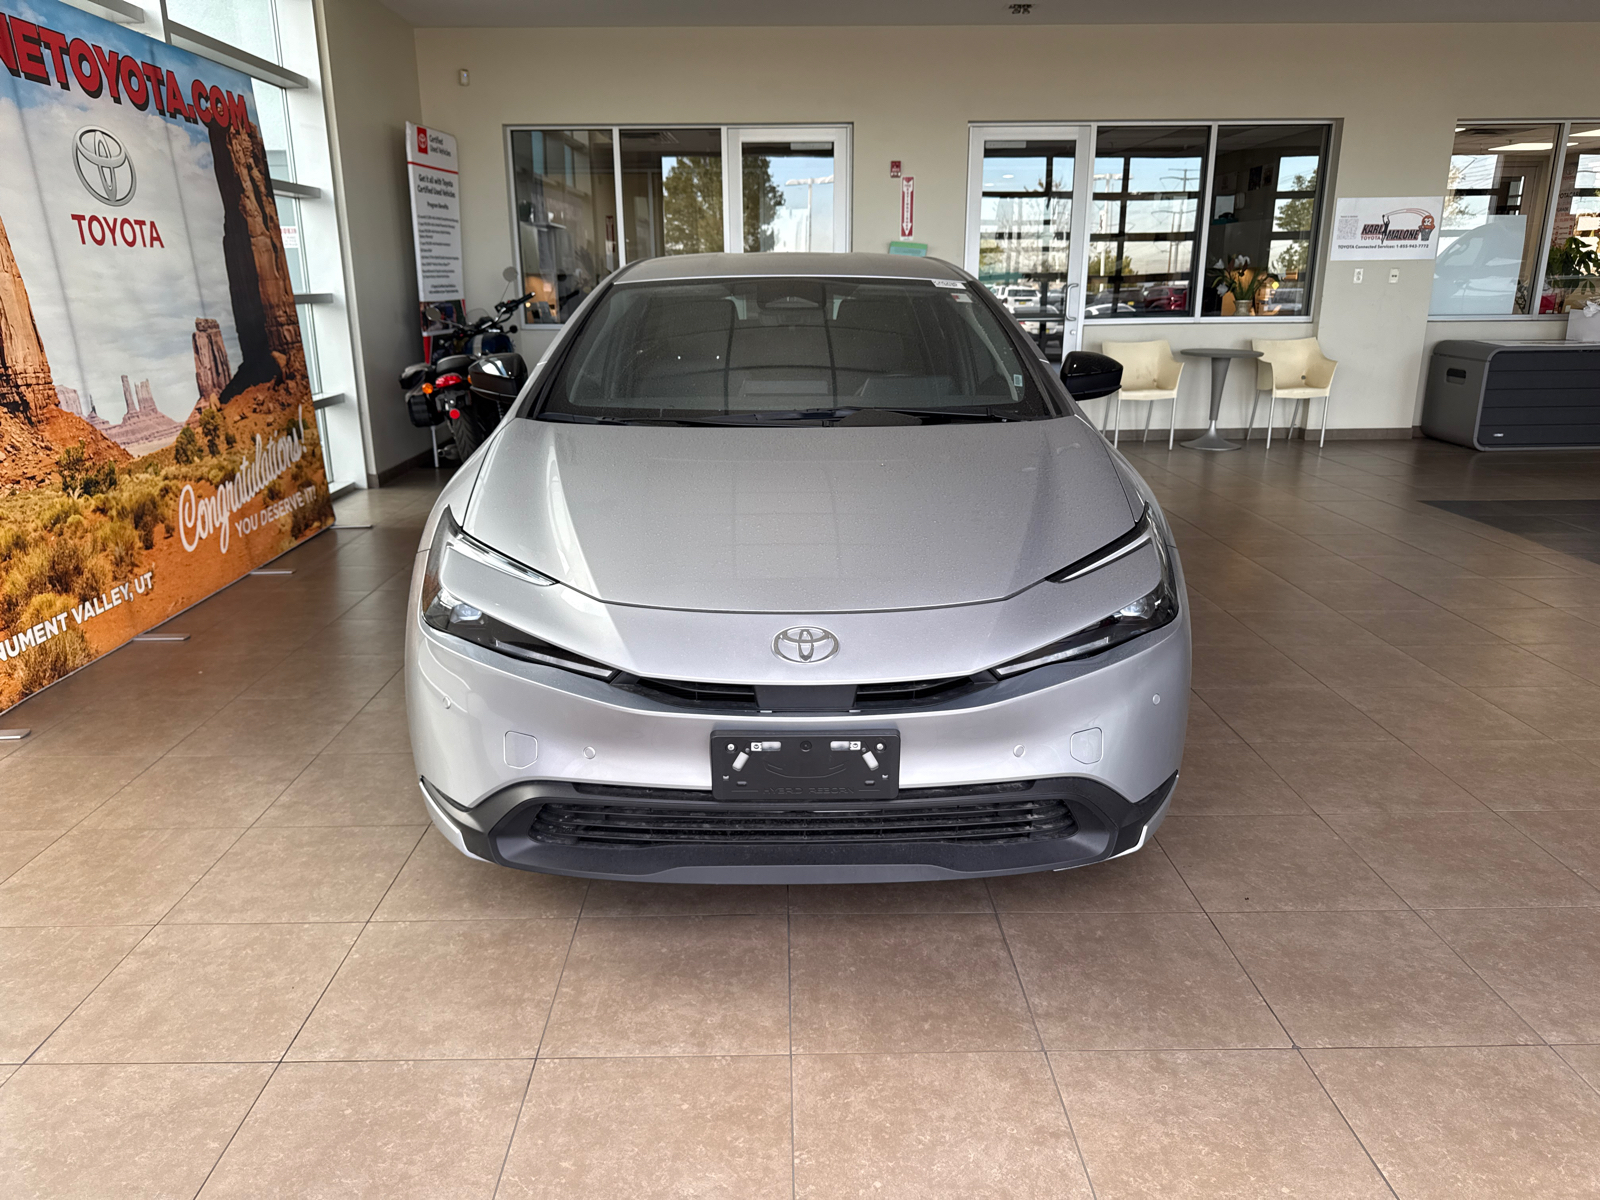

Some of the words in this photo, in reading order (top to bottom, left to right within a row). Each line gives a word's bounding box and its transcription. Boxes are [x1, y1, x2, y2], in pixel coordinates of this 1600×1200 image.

[71, 213, 165, 249] TOYOTA
[1361, 224, 1384, 235] KARL
[1423, 218, 1432, 226] 32
[1386, 229, 1420, 241] MALONE
[179, 404, 307, 554] Congratulations!
[235, 513, 258, 538] YOU
[260, 491, 305, 526] DESERVE
[303, 485, 317, 504] IT!
[71, 582, 134, 625] VALLEY,
[134, 571, 152, 594] UT
[763, 787, 803, 795] HYBRD
